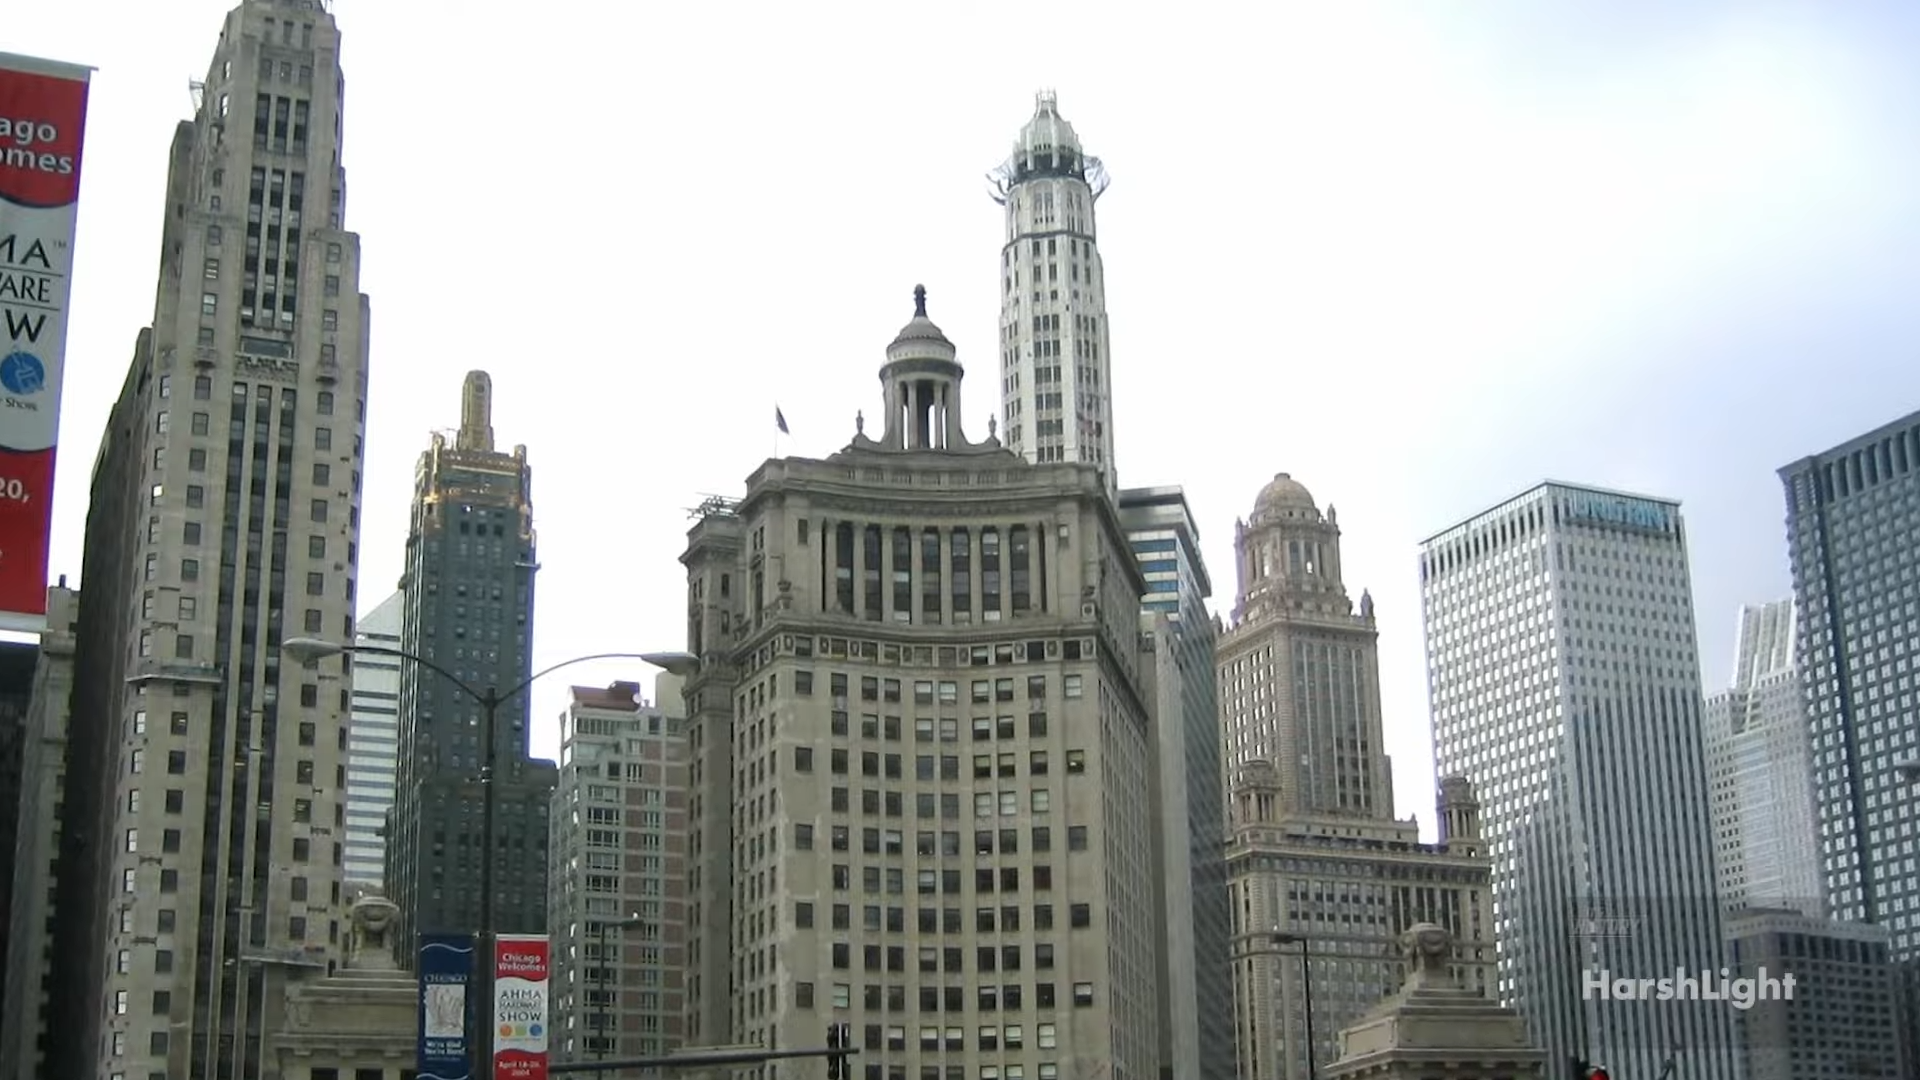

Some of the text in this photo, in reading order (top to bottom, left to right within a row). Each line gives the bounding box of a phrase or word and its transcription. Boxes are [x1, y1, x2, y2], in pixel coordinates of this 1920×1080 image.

[0, 146, 72, 174] mes
[5, 308, 47, 343] W
[502, 953, 541, 965] Chicago
[498, 961, 546, 972] Welcomes
[500, 989, 542, 999] AHMA
[499, 1011, 542, 1022] SHOW
